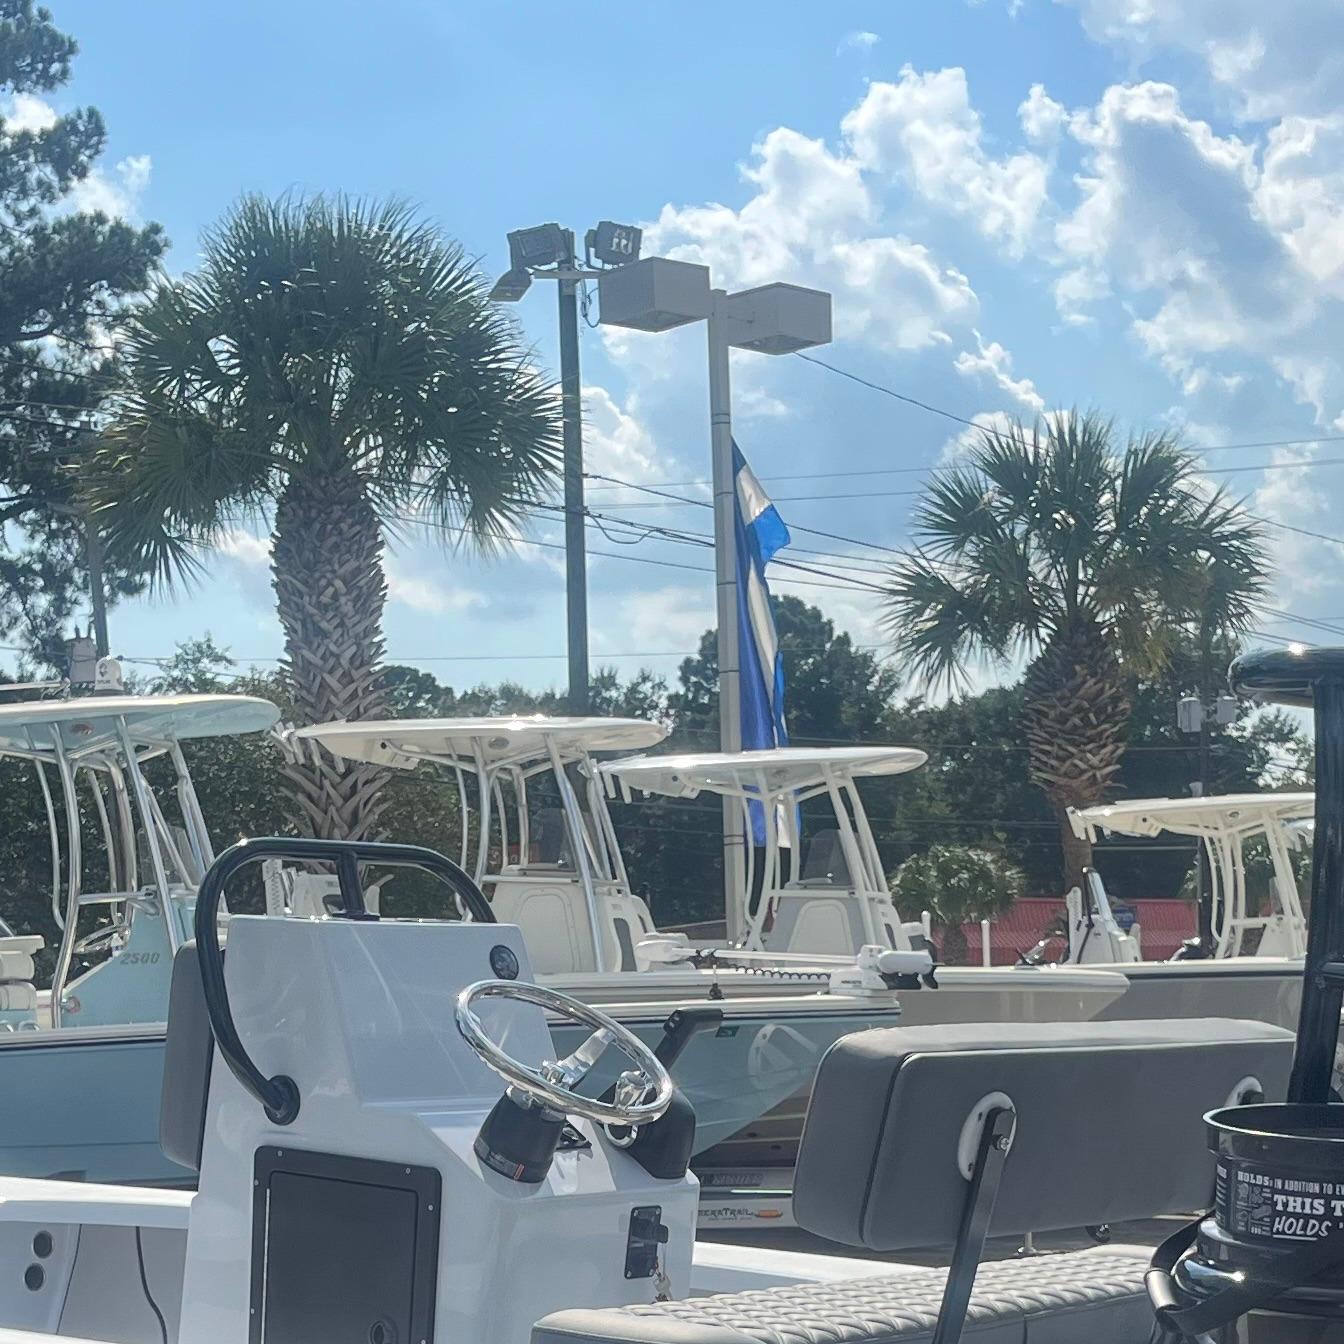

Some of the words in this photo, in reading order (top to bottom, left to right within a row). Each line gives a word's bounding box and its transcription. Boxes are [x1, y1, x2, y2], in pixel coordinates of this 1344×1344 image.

[119, 952, 161, 965] 2500
[1274, 1178, 1283, 1190] IN
[1284, 1179, 1320, 1194] ADDITION
[1322, 1183, 1334, 1195] TO
[1273, 1194, 1325, 1216] THIS
[1272, 1216, 1333, 1238] HOLDS
